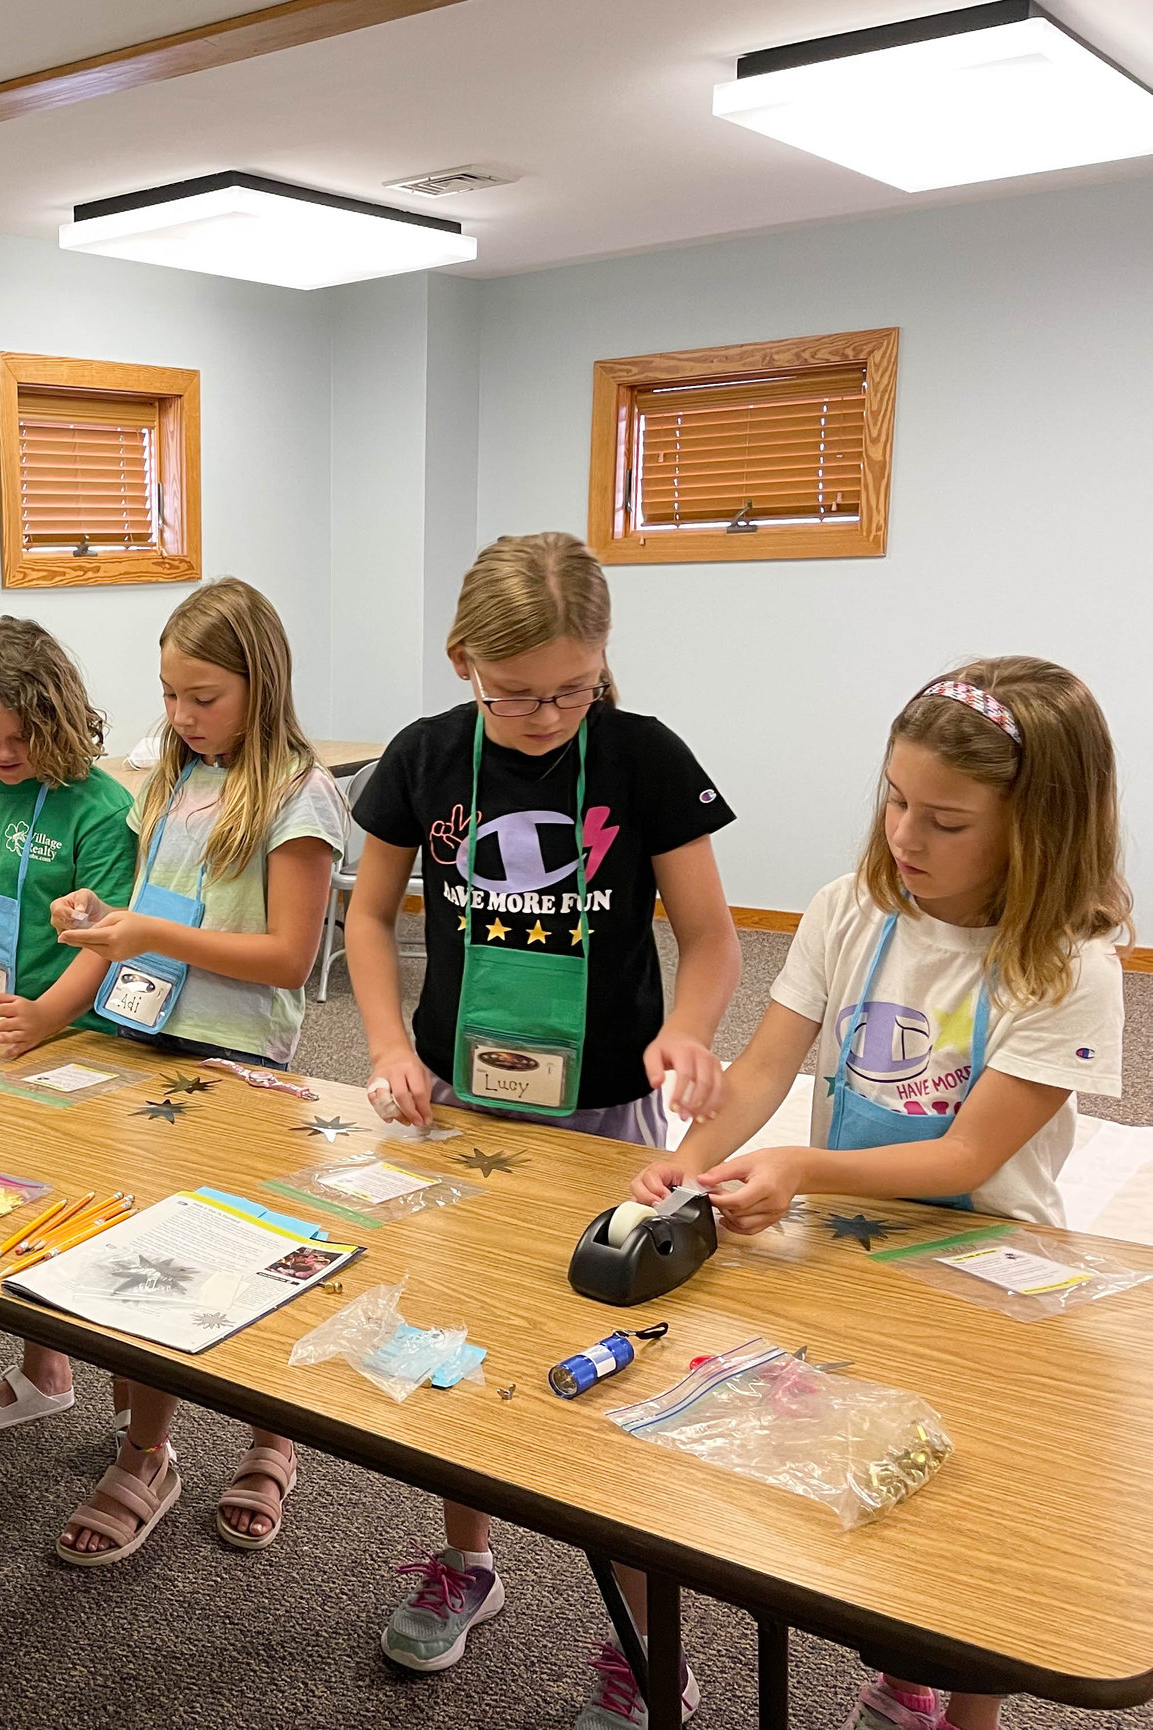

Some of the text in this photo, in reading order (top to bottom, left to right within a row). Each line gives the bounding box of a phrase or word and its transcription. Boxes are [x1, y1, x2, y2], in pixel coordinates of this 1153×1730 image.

[487, 891, 556, 914] MORE
[560, 889, 612, 914] FUN
[485, 1073, 530, 1098] Lucy
[896, 1078, 931, 1100] HAVE
